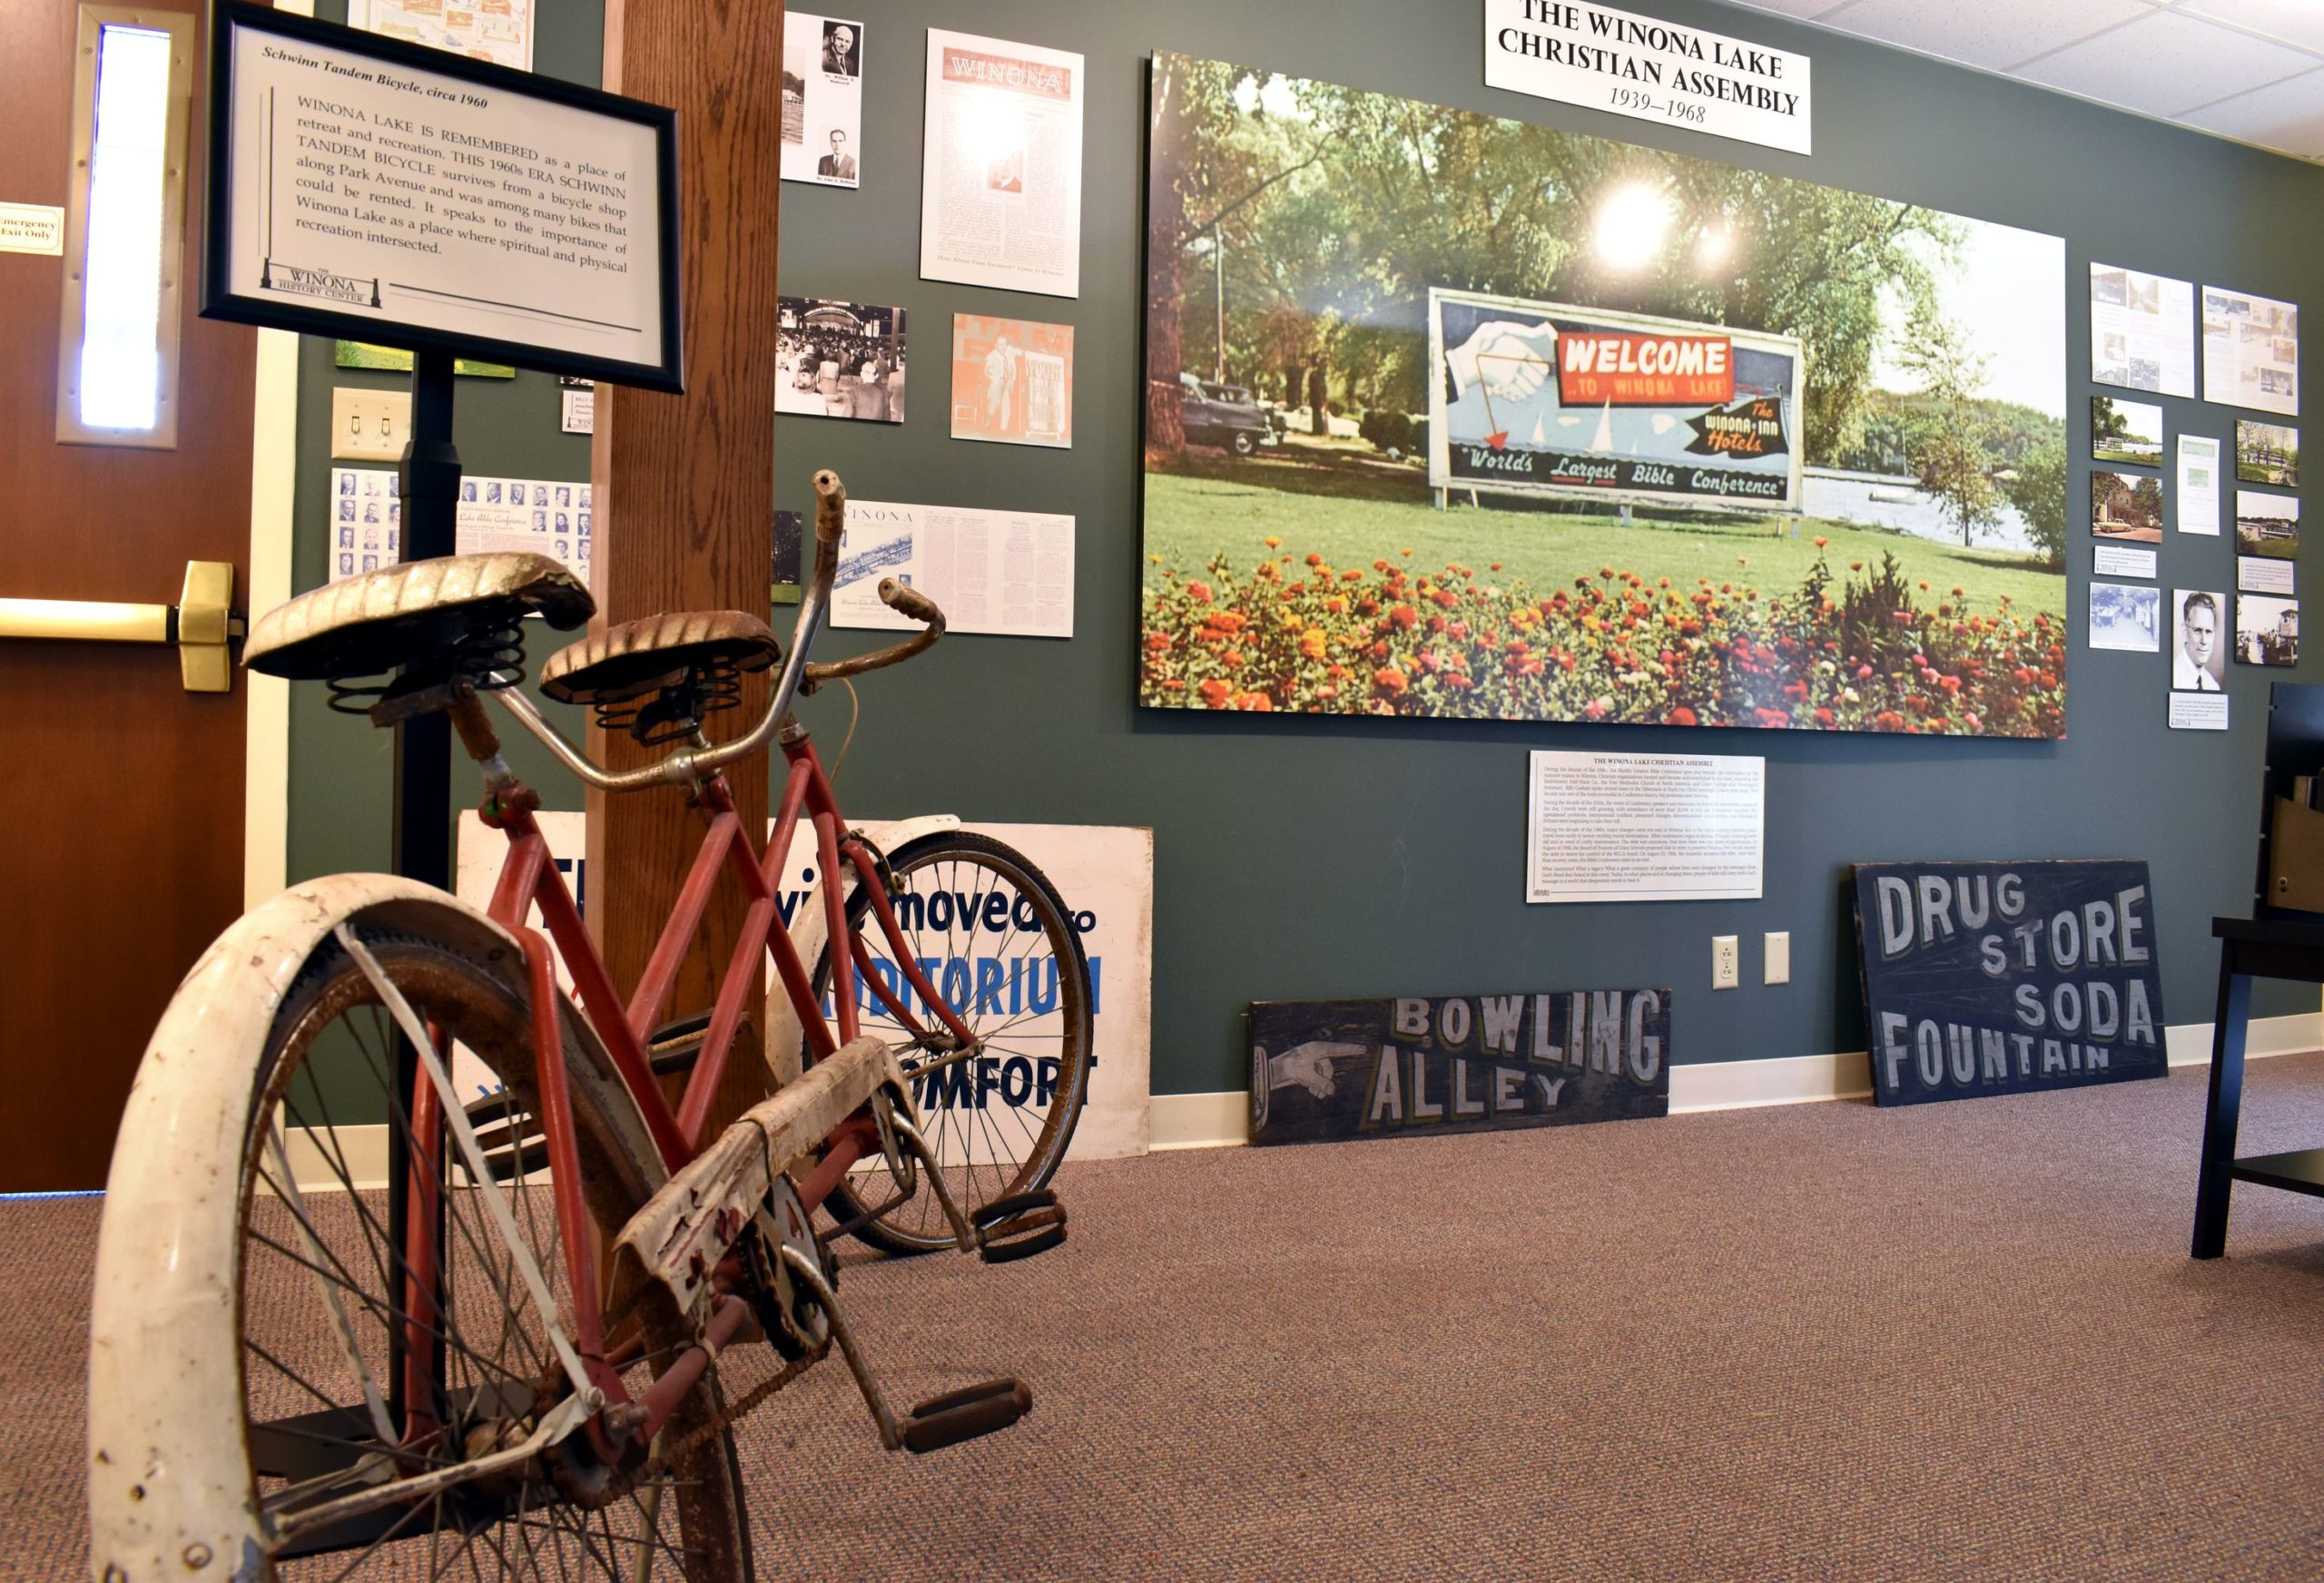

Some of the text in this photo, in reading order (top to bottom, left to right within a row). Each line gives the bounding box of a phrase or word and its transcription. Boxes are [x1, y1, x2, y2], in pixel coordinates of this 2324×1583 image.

[1498, 28, 1800, 116] CHRISTIAN ASSEMBLY
[1519, 0, 1783, 79] THE WINONA LAKE
[261, 46, 488, 110] Schwinn Tandem Bicycle, circa 1960
[951, 56, 1063, 93] WINONA
[297, 118, 625, 200] retreat and recreation. THIS 1960s ERA SCHWINN
[298, 95, 626, 182] WINONA LAKE IS REMEMBERED as a place of
[296, 155, 626, 237] along Park Avenue and was among many bikes that
[297, 134, 626, 221] TANDEM BICYCLE survives from a bicycle shop
[2, 228, 52, 241] Exit Only
[295, 178, 627, 255] could be rented. It speaks to the importance of
[296, 194, 627, 273] Winona Lake as a place where spiritual and physical
[296, 218, 442, 254] recreation intersected.
[279, 280, 364, 302] HISTORY CENTER
[290, 269, 356, 292] WINONA
[1565, 339, 1728, 376] WELCOME
[1614, 379, 1675, 398] WINONA
[1708, 429, 1763, 452] Hotels
[1752, 401, 1773, 418] The
[1551, 458, 1617, 484] Largest
[1632, 465, 1675, 486] Bible
[889, 890, 1042, 932] moved
[1876, 872, 2026, 956] DRUG
[1981, 885, 2150, 976] STORE
[821, 956, 1102, 1018] DITORIU
[2014, 978, 2156, 1046] SODA
[1394, 989, 1660, 1083] BOWLING
[1880, 1010, 2110, 1089] FOUNTAIN
[901, 1055, 1098, 1110] OMFOR
[1369, 1044, 1568, 1122] ALLEY
